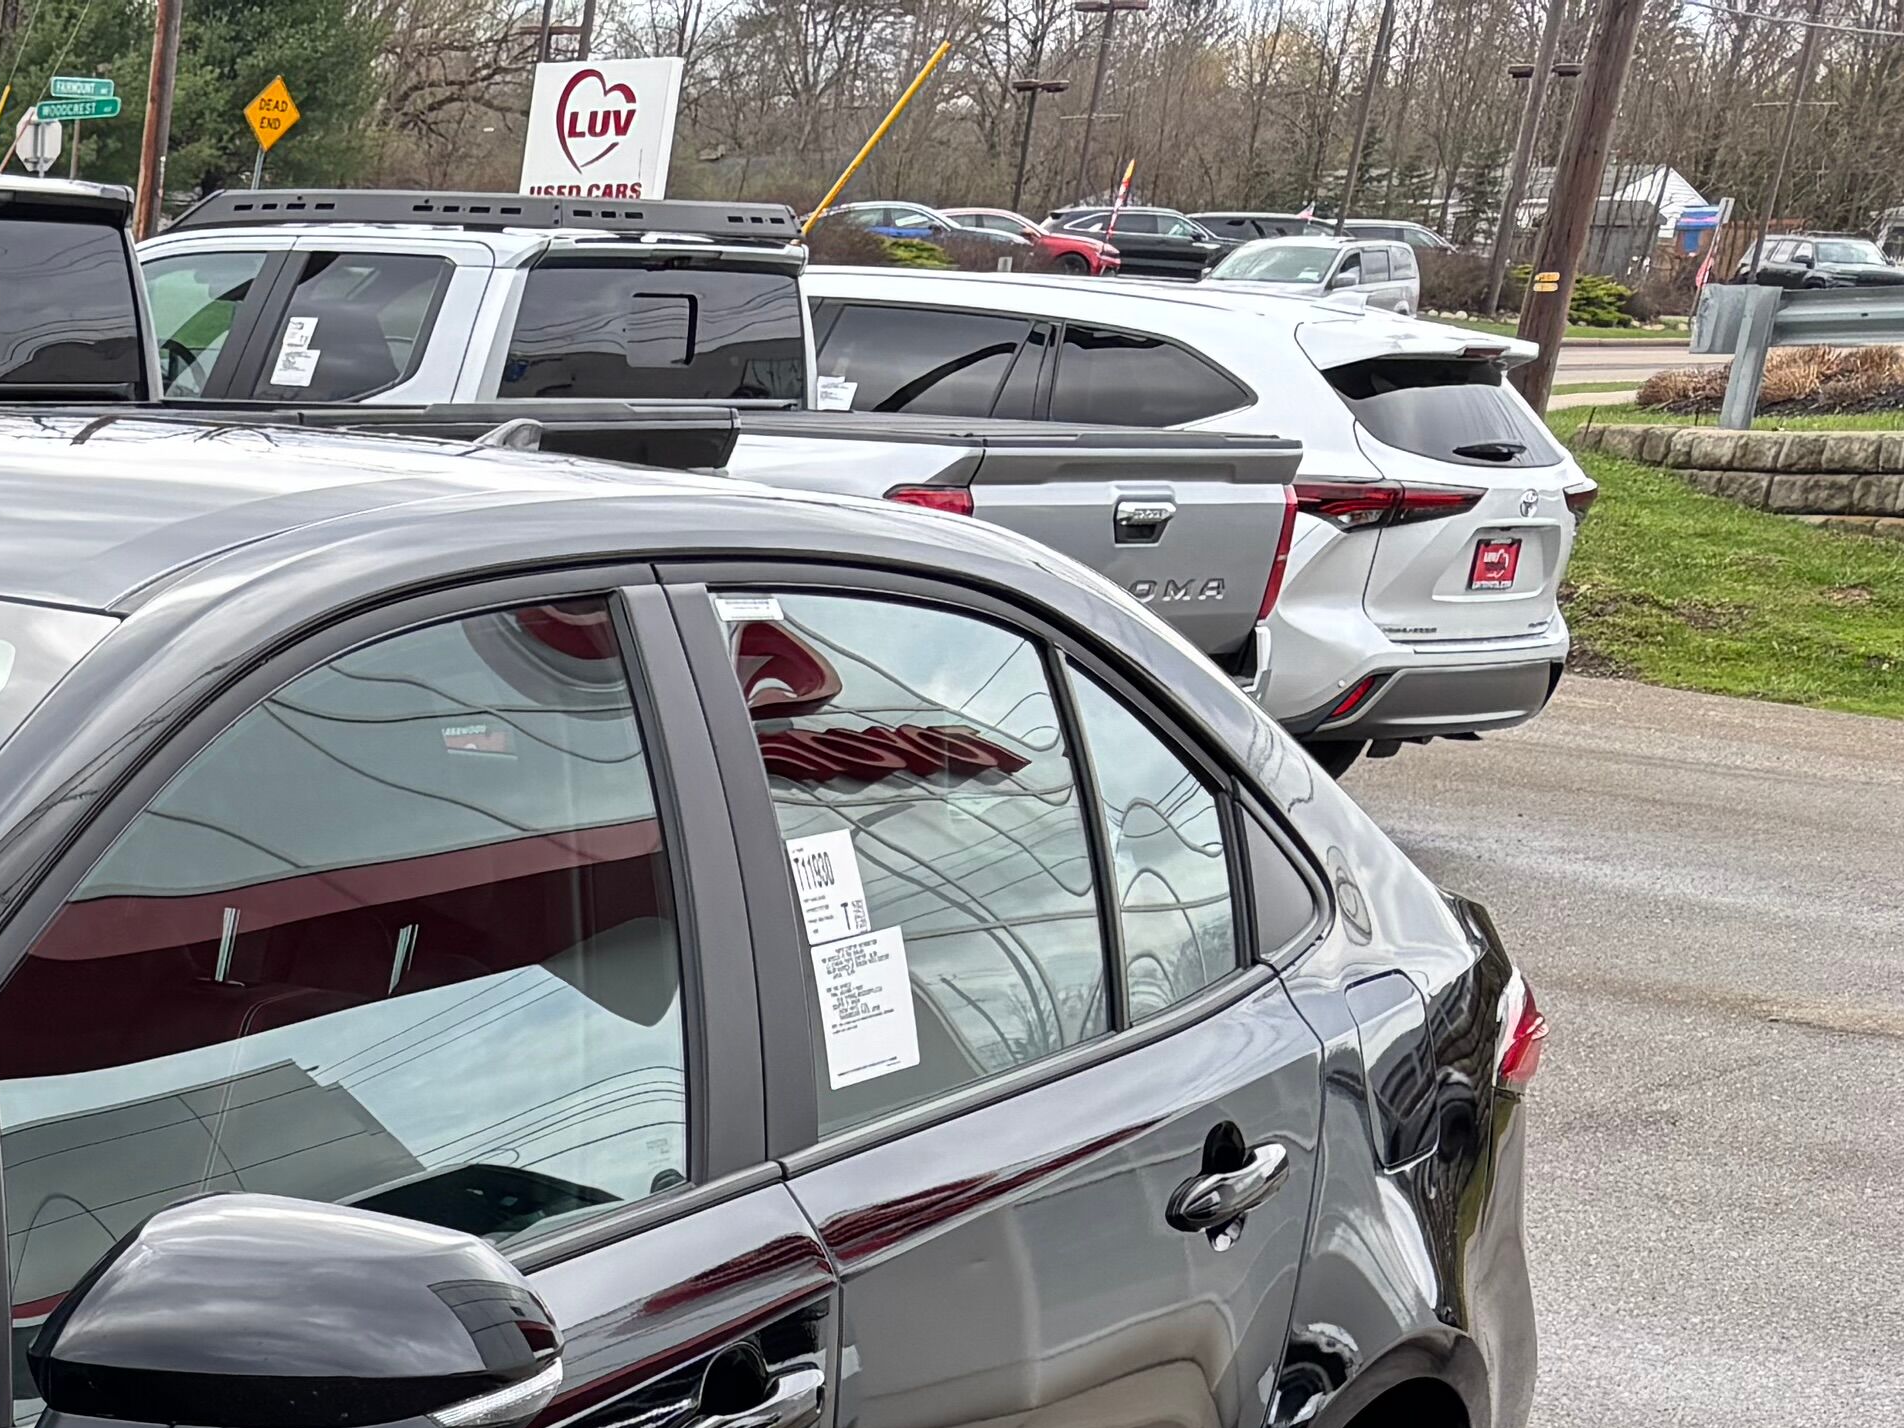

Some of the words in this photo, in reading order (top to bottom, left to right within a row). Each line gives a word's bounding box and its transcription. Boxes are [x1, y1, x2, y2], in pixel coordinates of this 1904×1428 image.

[42, 102, 96, 117] WOODCREST
[259, 98, 288, 112] DEAD
[260, 116, 281, 130] END
[568, 109, 637, 138] LUV
[587, 182, 642, 200] CARS
